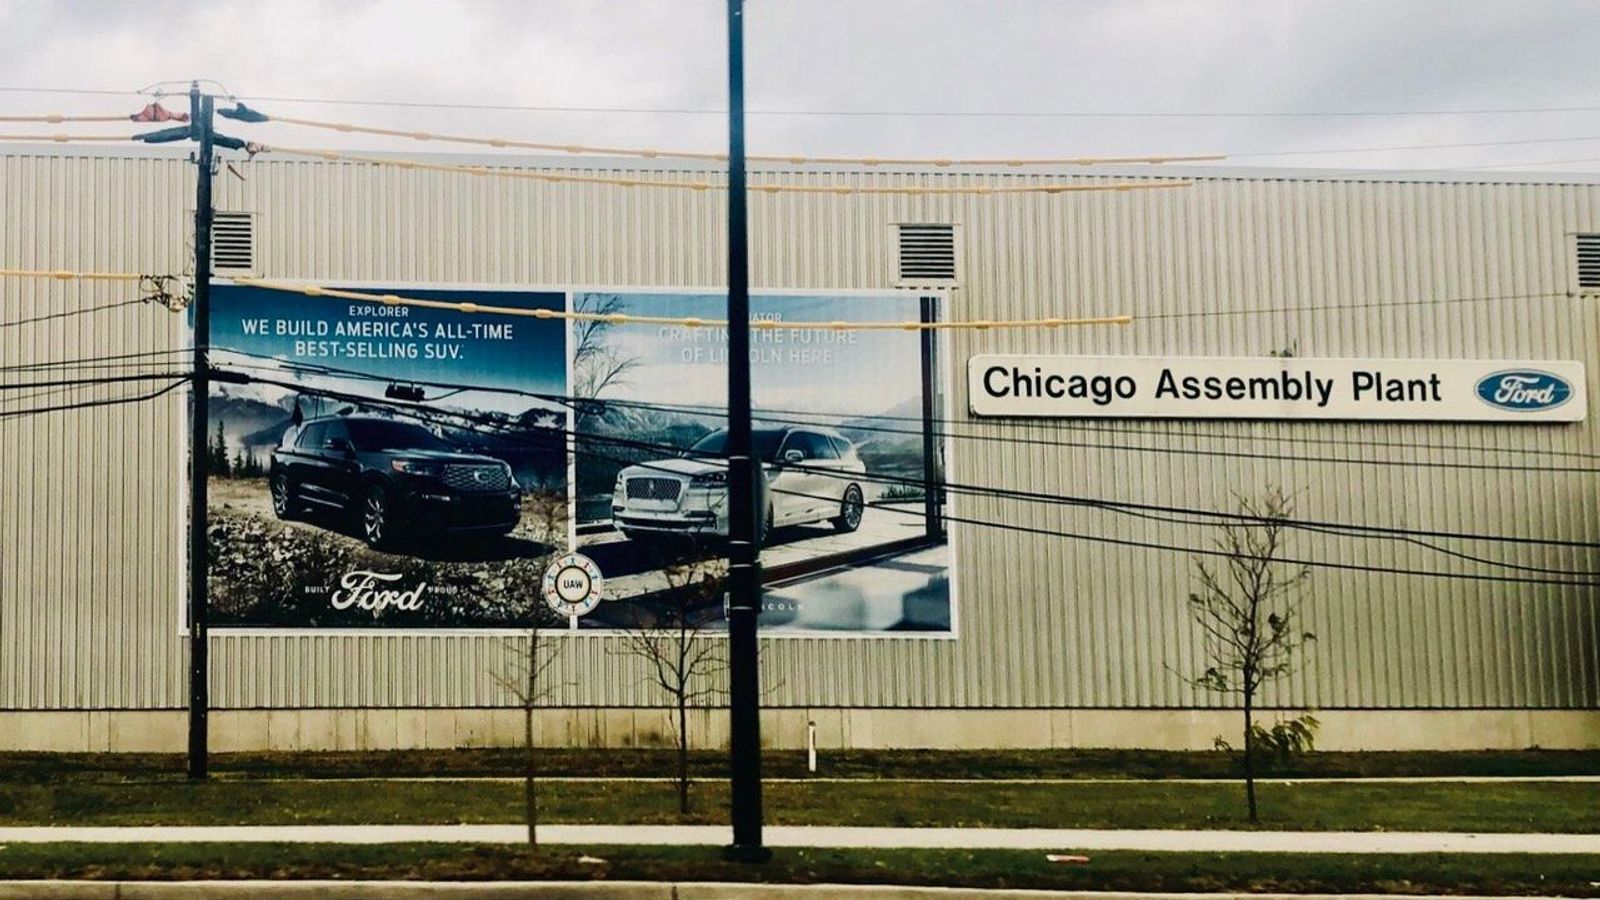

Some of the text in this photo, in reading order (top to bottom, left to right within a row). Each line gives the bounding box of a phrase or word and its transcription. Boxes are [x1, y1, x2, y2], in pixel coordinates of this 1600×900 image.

[349, 305, 409, 318] EXPLORER
[242, 319, 513, 340] WE BUILD AMERICA'S ALL-TIME
[660, 327, 857, 345] CRAFTIN THE FUTURE
[295, 341, 463, 360] BEST-SELLING SUV.
[681, 347, 703, 362] OF
[983, 366, 1557, 407] Chicago Assembly Plant Ford
[304, 585, 330, 594] BUILT
[331, 570, 427, 611] Ford
[563, 579, 583, 590] UAW
